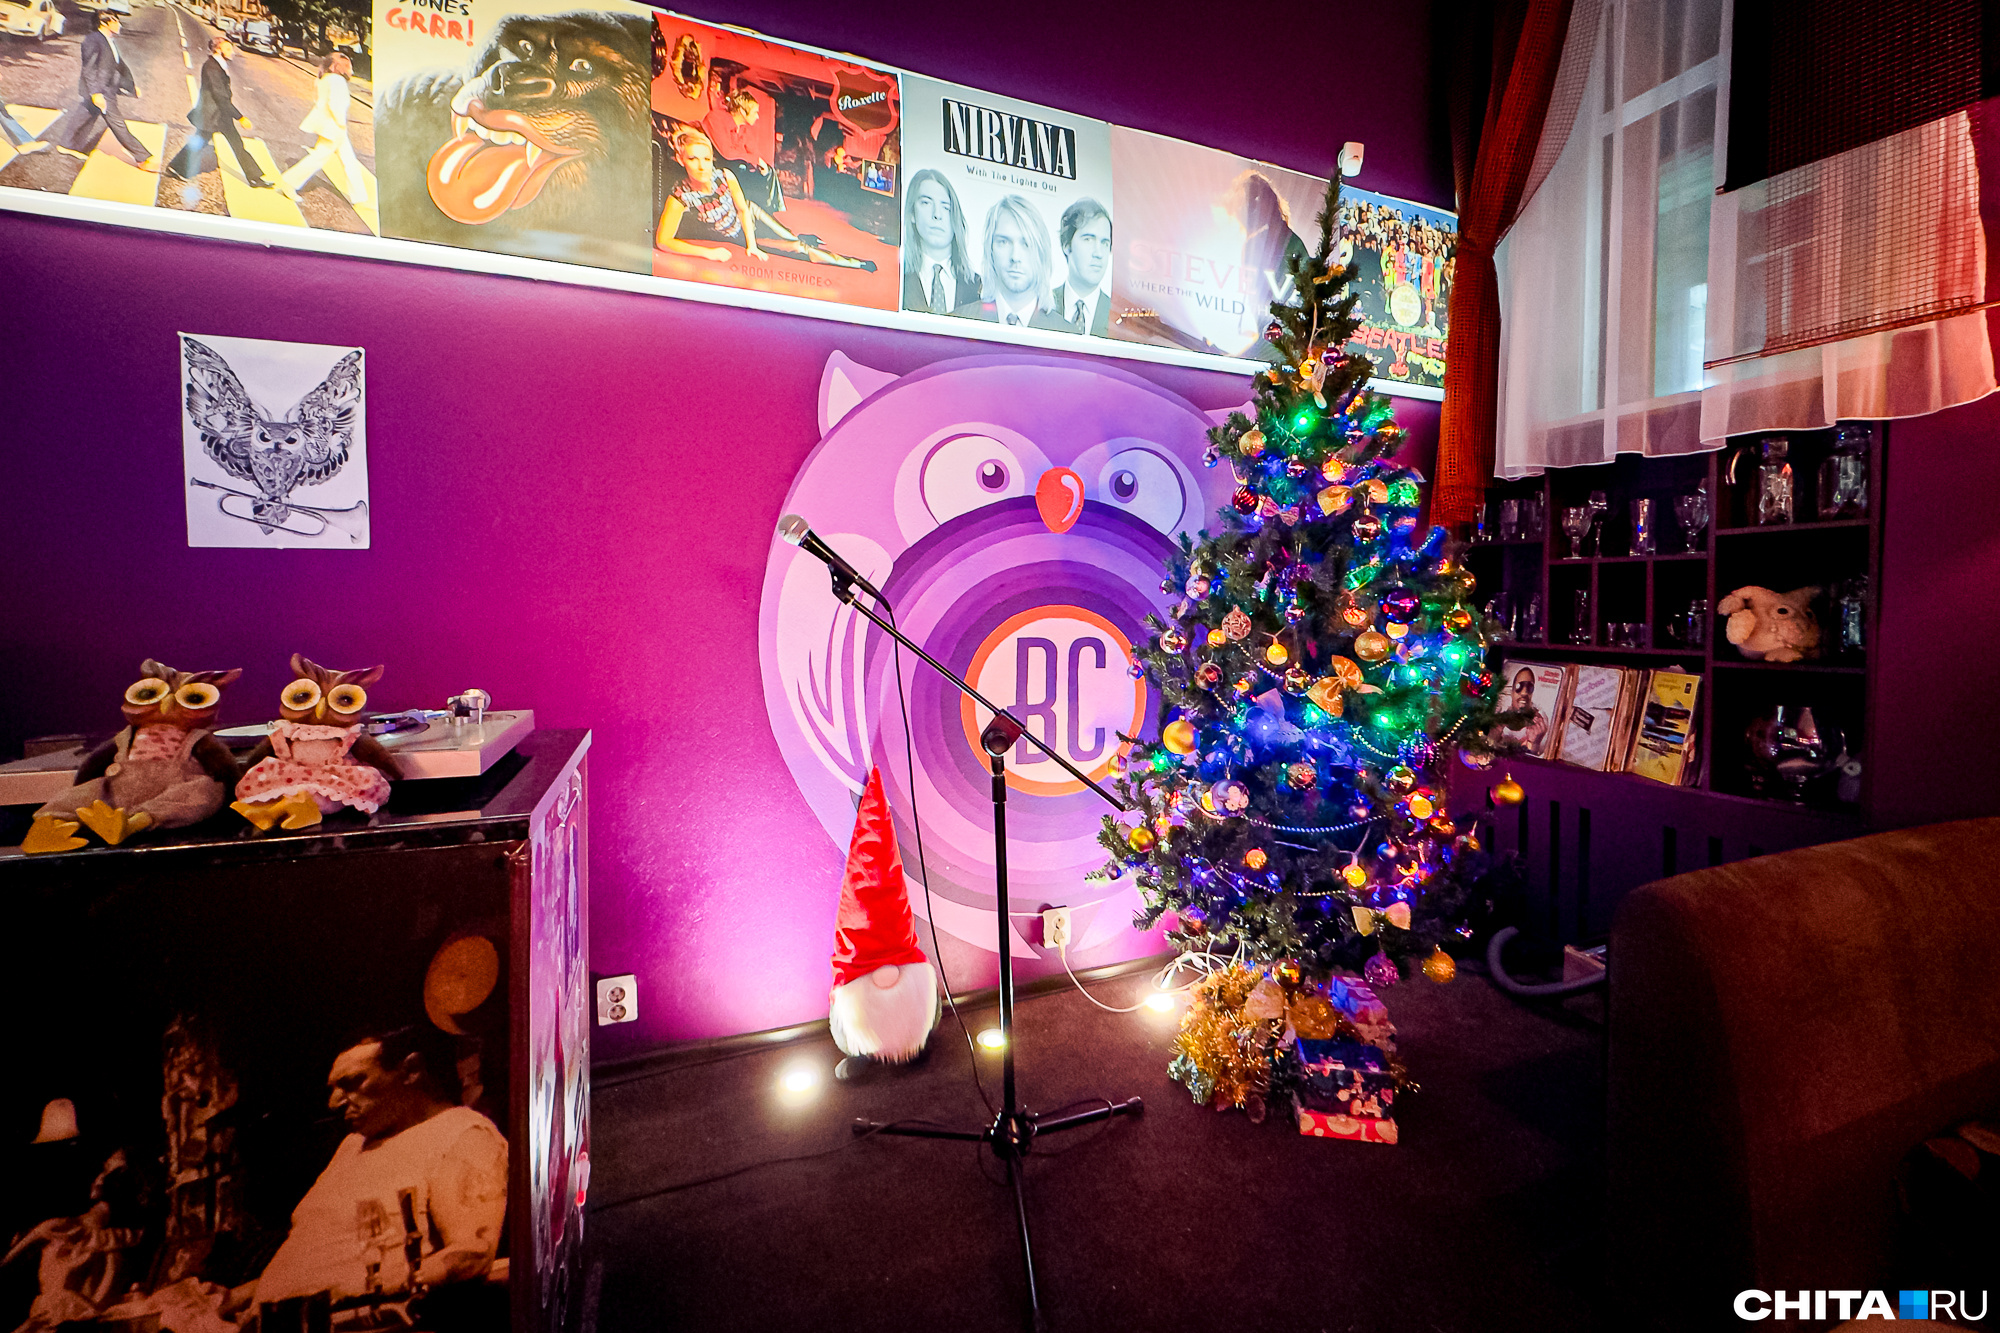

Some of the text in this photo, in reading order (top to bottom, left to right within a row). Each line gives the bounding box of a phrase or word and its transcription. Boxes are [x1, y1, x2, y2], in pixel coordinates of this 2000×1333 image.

[385, 8, 474, 47] GRRR!
[948, 101, 1073, 178] NIRVANA
[966, 165, 1057, 192] With The Lights Out
[742, 265, 822, 287] ROOM SERVICE
[1128, 240, 1257, 295] STEVE
[1129, 279, 1174, 295] WHERE
[1176, 287, 1194, 298] THE
[1196, 292, 1245, 315] WILD
